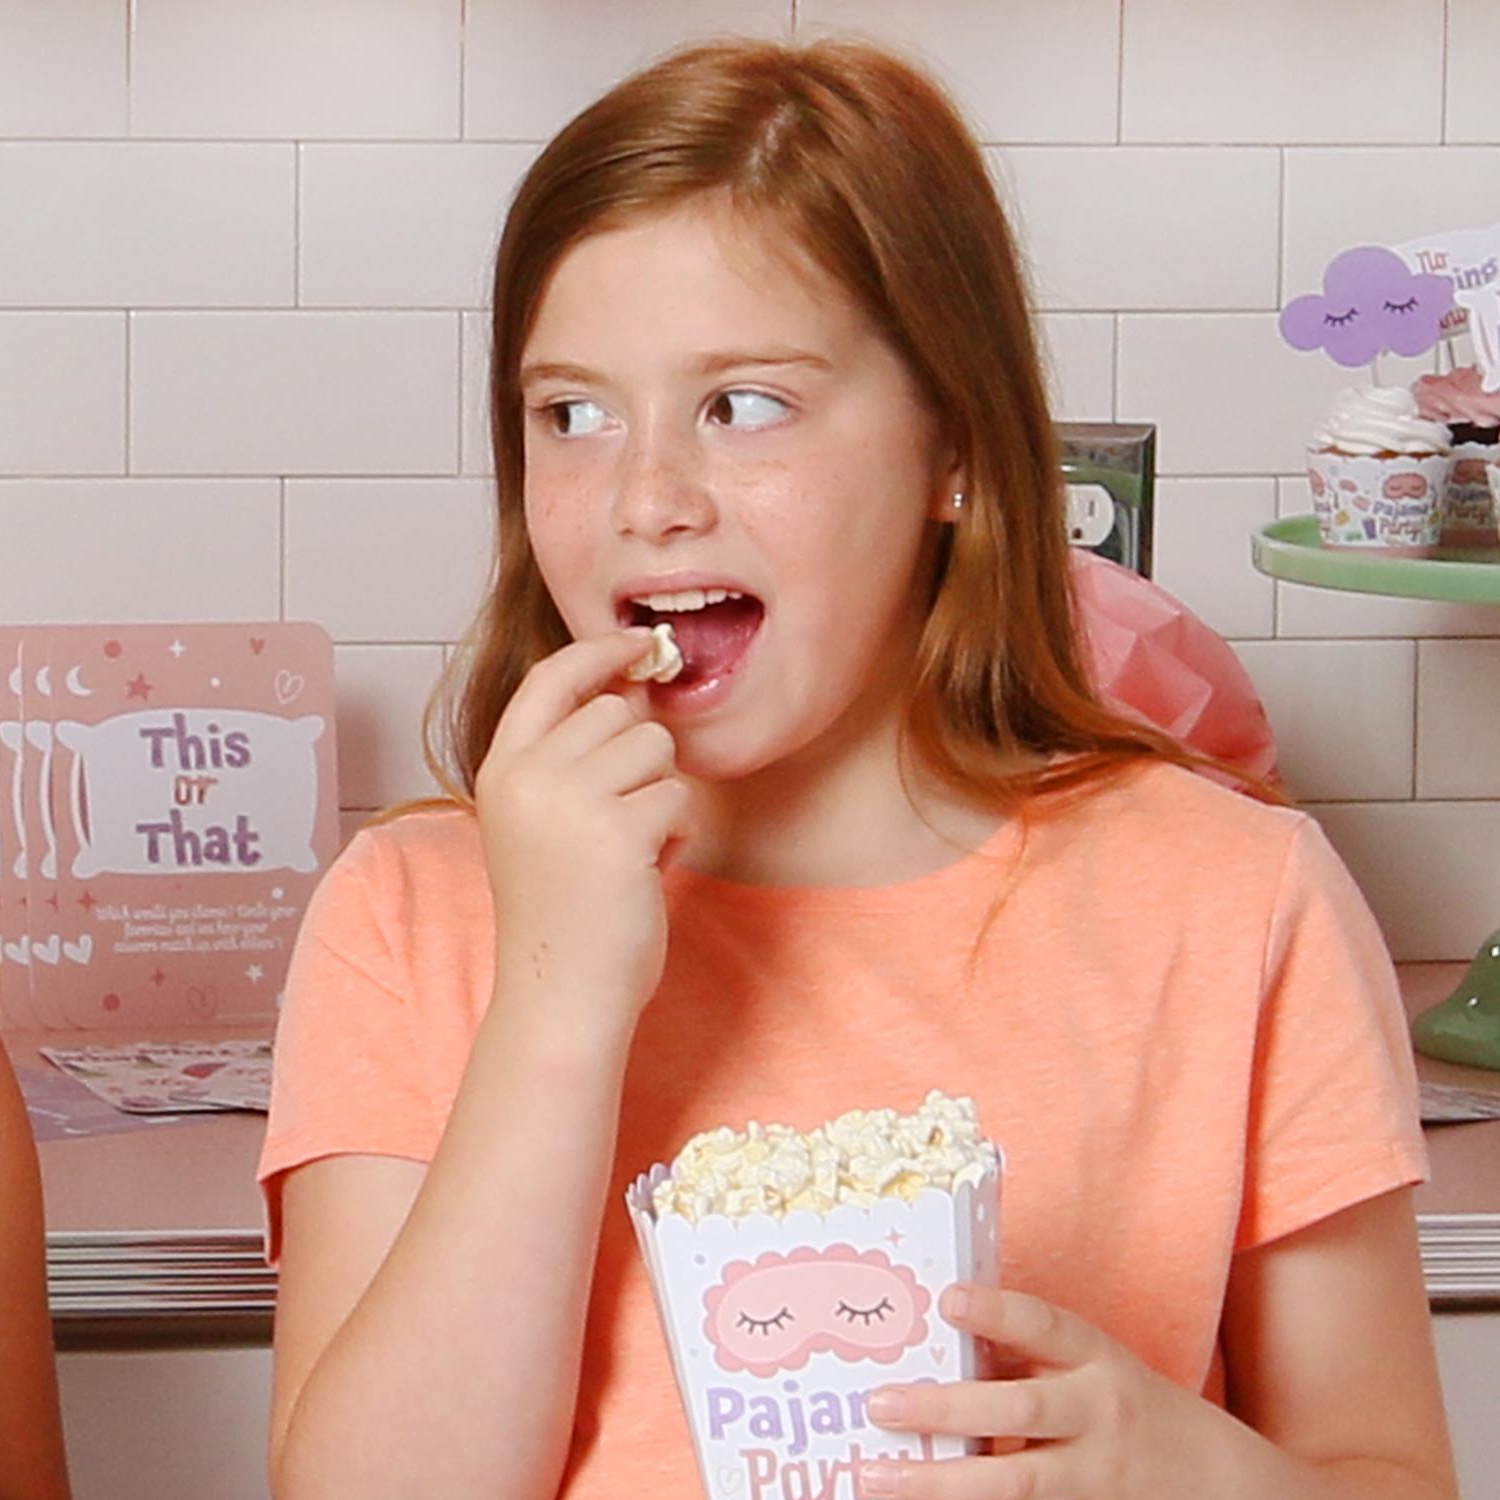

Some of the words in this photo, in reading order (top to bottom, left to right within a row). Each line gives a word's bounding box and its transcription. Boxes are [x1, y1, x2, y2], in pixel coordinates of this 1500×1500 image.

[139, 713, 253, 770] This
[135, 808, 262, 866] That
[706, 1377, 940, 1456] Paja
